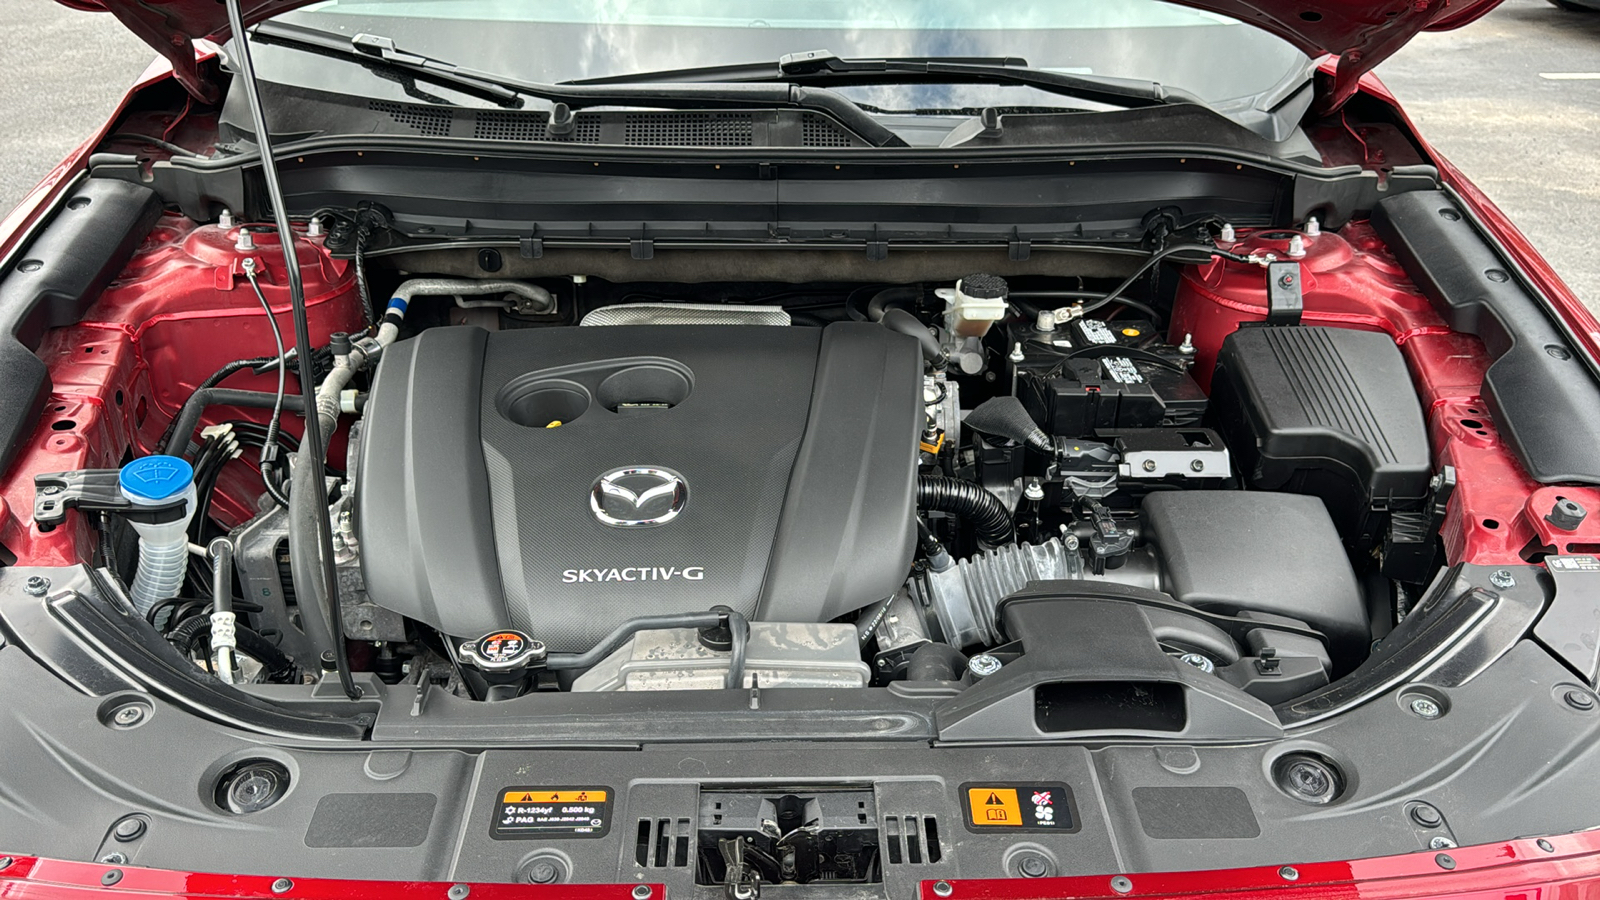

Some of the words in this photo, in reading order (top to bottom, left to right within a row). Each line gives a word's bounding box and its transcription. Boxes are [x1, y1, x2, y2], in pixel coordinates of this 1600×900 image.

[562, 566, 704, 583] SKYACTIV-G
[517, 806, 553, 815] R-1234yf
[562, 806, 583, 814] 0.500
[584, 806, 595, 814] kg
